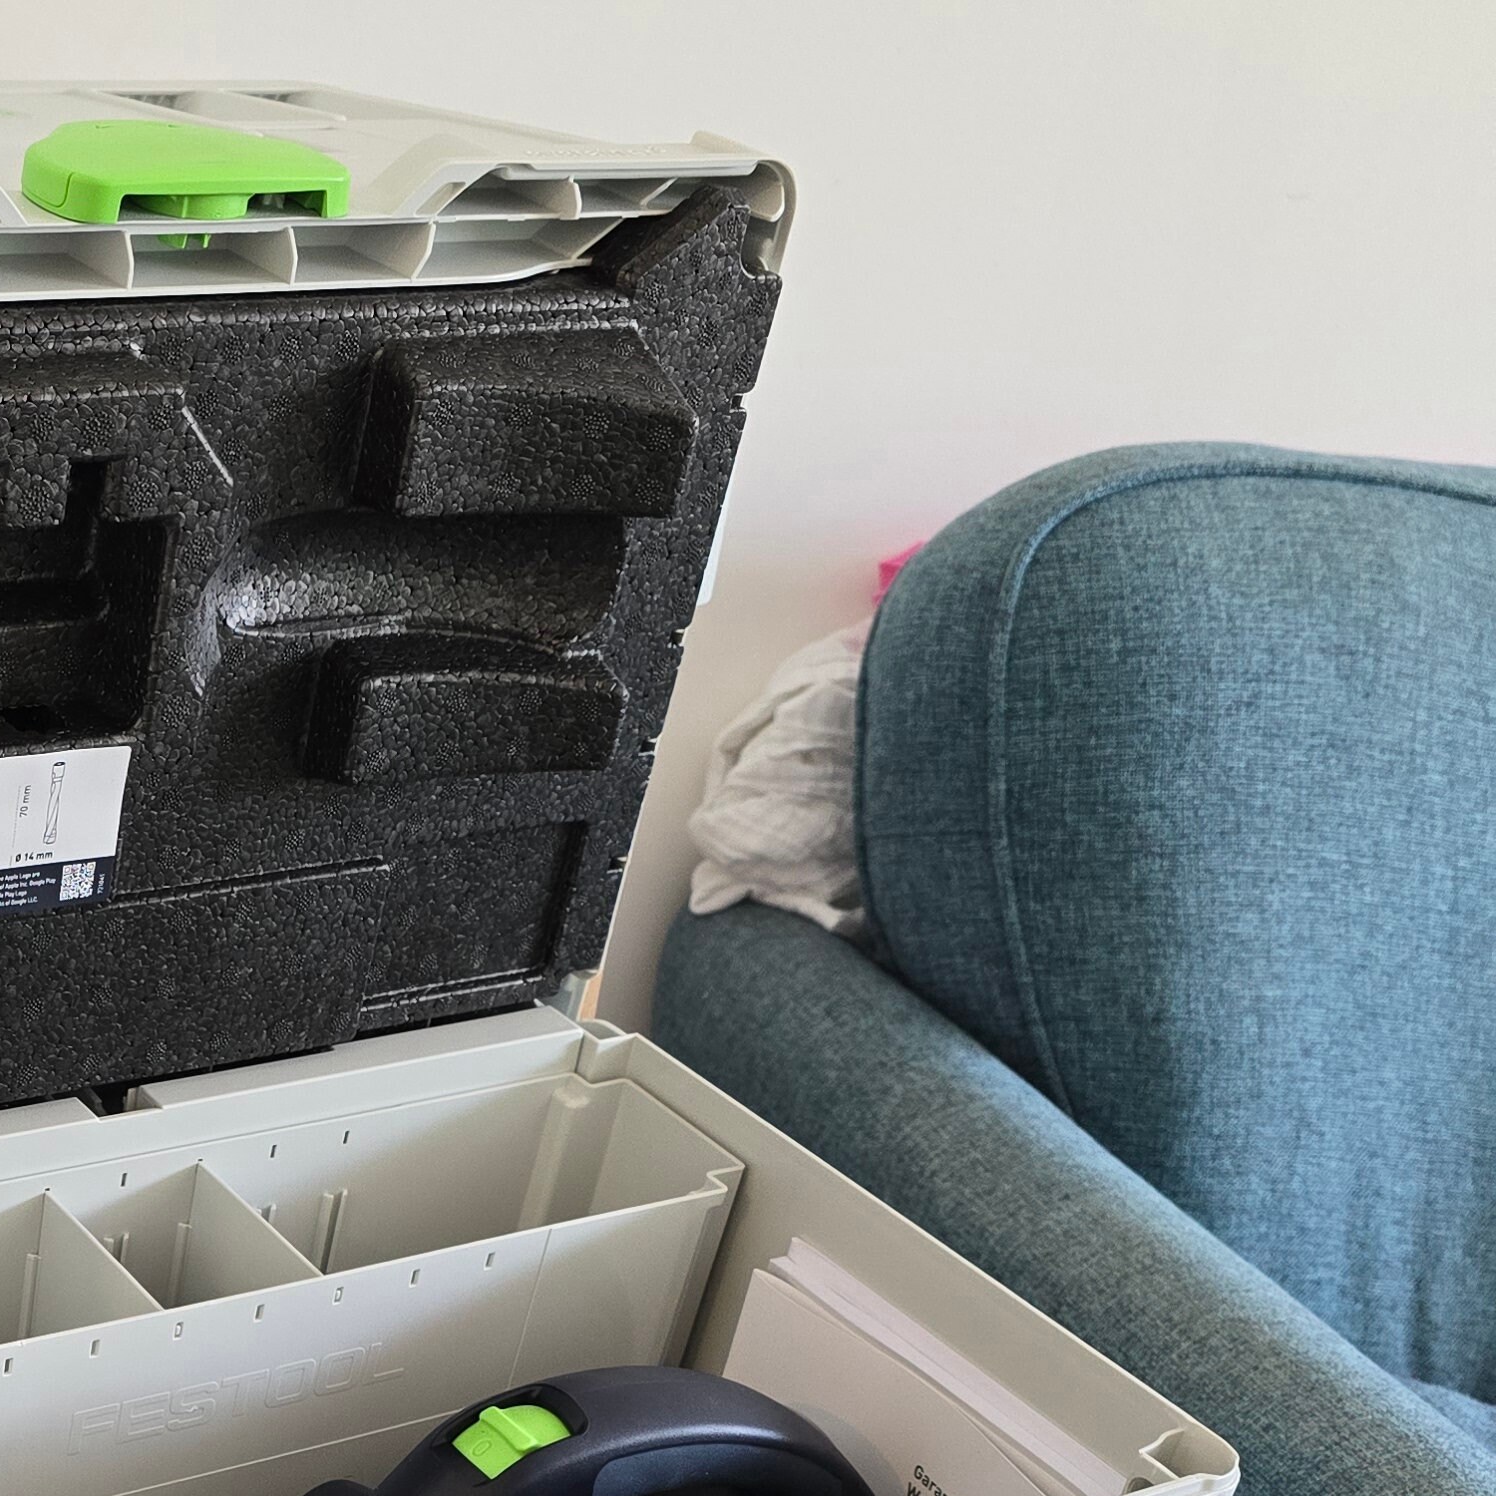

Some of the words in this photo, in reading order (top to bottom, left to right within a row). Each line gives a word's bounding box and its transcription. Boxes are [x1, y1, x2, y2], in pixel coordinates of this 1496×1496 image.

[23, 785, 31, 804] mm
[19, 806, 28, 818] 70
[24, 852, 34, 861] 14
[36, 851, 53, 860] mm
[68, 1342, 404, 1455] FESTOOL
